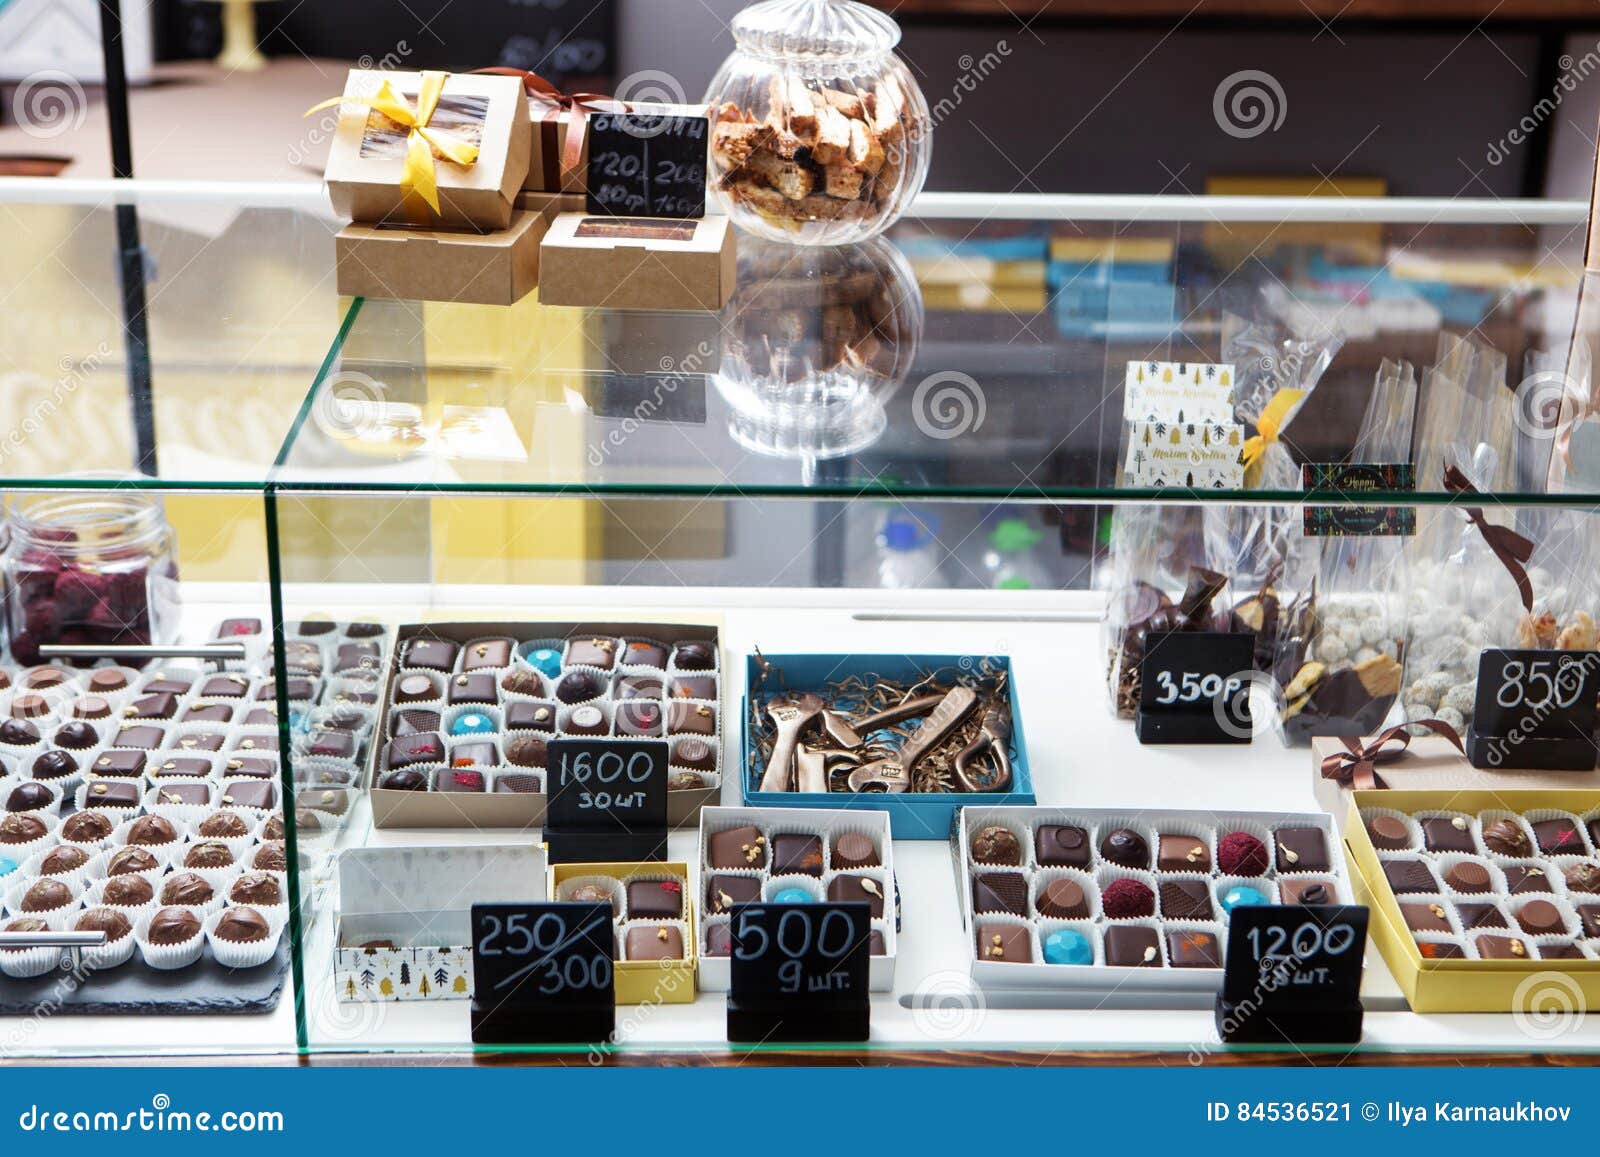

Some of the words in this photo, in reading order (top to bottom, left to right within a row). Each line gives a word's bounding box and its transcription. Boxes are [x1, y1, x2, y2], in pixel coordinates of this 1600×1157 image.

[1496, 660, 1586, 708] 850
[560, 751, 655, 787] 1600
[734, 909, 856, 961] 500
[1246, 921, 1356, 962] 1200
[538, 954, 612, 995] 300
